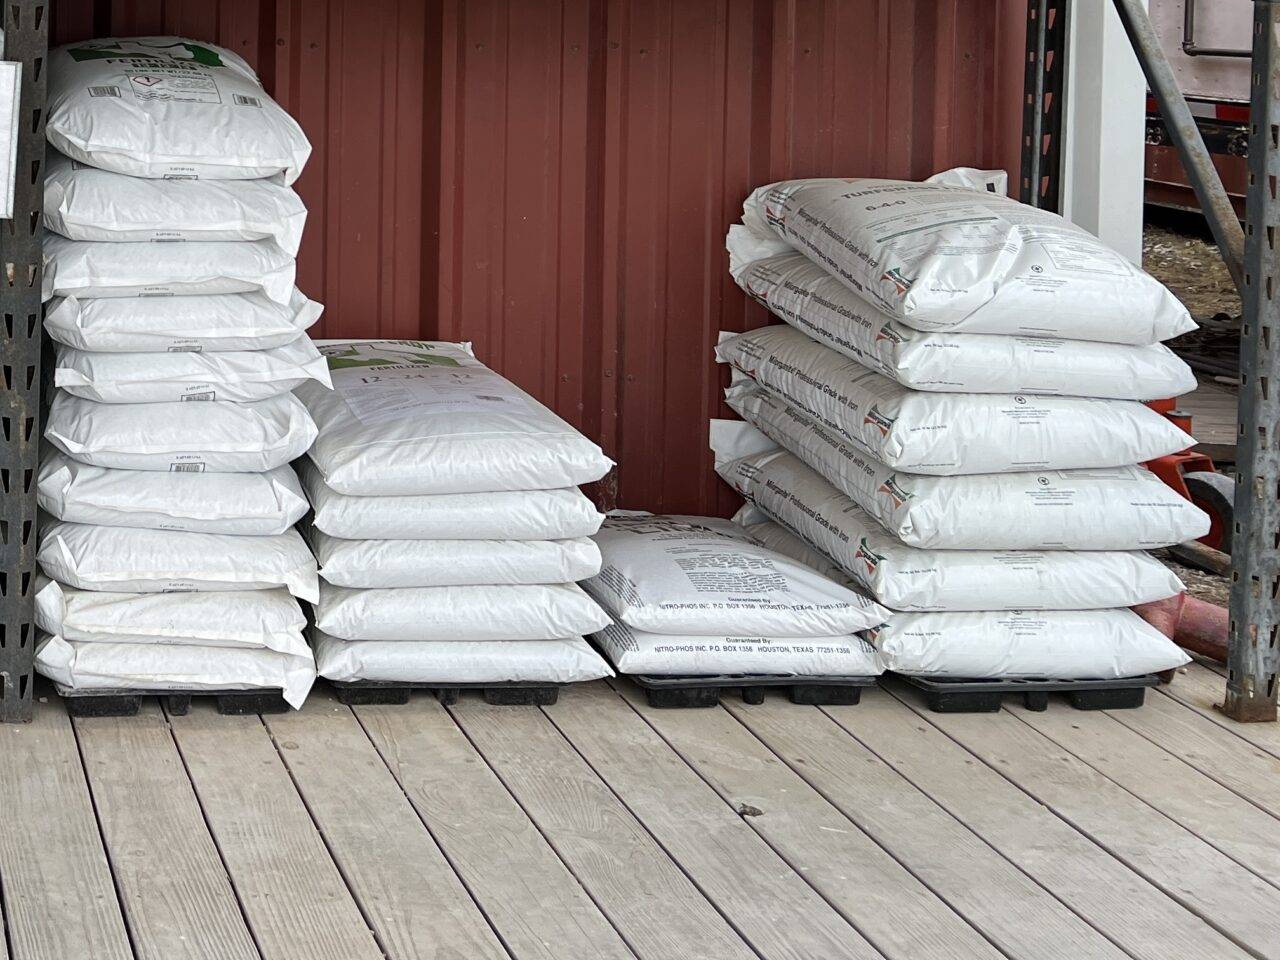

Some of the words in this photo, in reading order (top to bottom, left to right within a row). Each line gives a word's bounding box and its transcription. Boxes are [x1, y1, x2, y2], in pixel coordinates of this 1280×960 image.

[865, 200, 906, 212] 6-4-0
[838, 444, 854, 459] Grade
[853, 454, 865, 470] with
[863, 465, 875, 477] Iron
[815, 513, 830, 528] Grade
[828, 522, 842, 536] with
[757, 646, 791, 654] HOUSTON,
